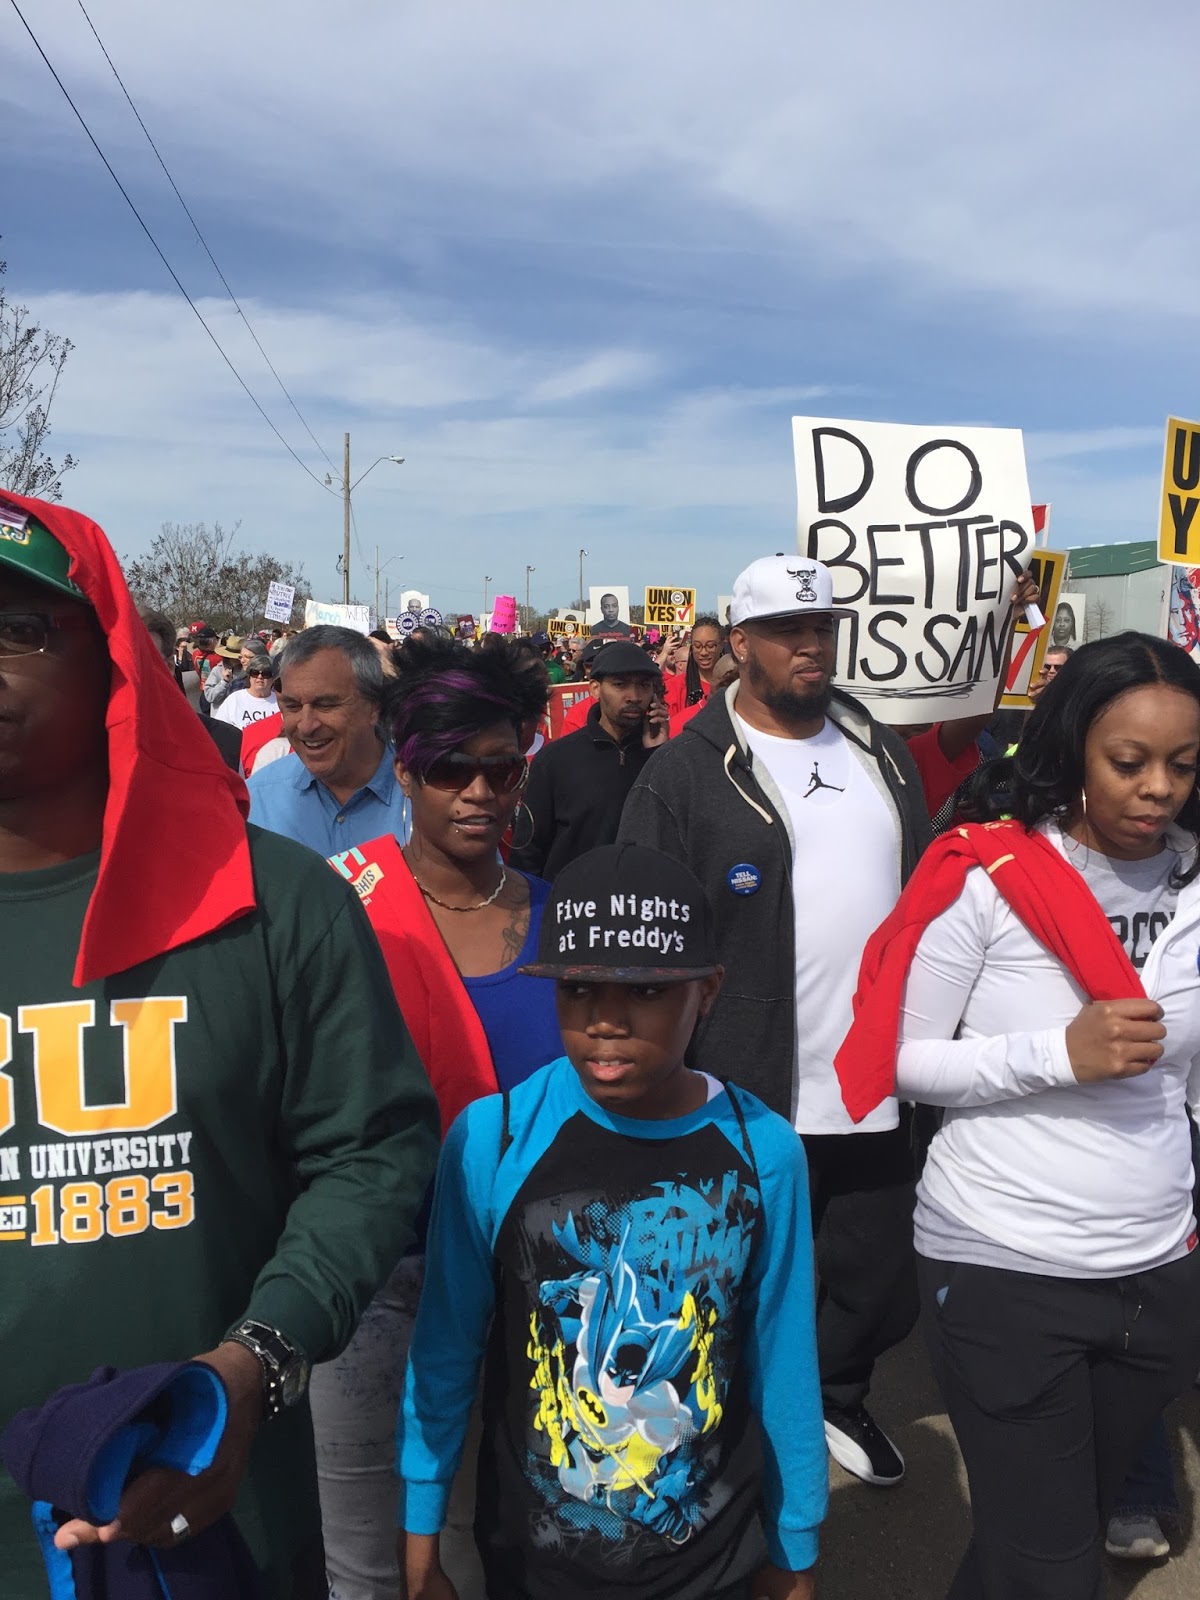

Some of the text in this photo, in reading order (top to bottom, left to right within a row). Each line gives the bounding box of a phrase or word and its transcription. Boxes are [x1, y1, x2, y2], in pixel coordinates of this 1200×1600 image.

[812, 427, 983, 516] DO
[807, 516, 1029, 613] BETTER
[648, 605, 676, 622] YES
[649, 588, 692, 606] UNION
[832, 609, 1014, 683] ISSAN
[735, 871, 751, 879] TELL
[556, 894, 691, 924] Five Nights
[559, 925, 685, 955] at Freddy's
[29, 1131, 193, 1180] UNIVERSITY
[30, 1170, 196, 1247] 1883
